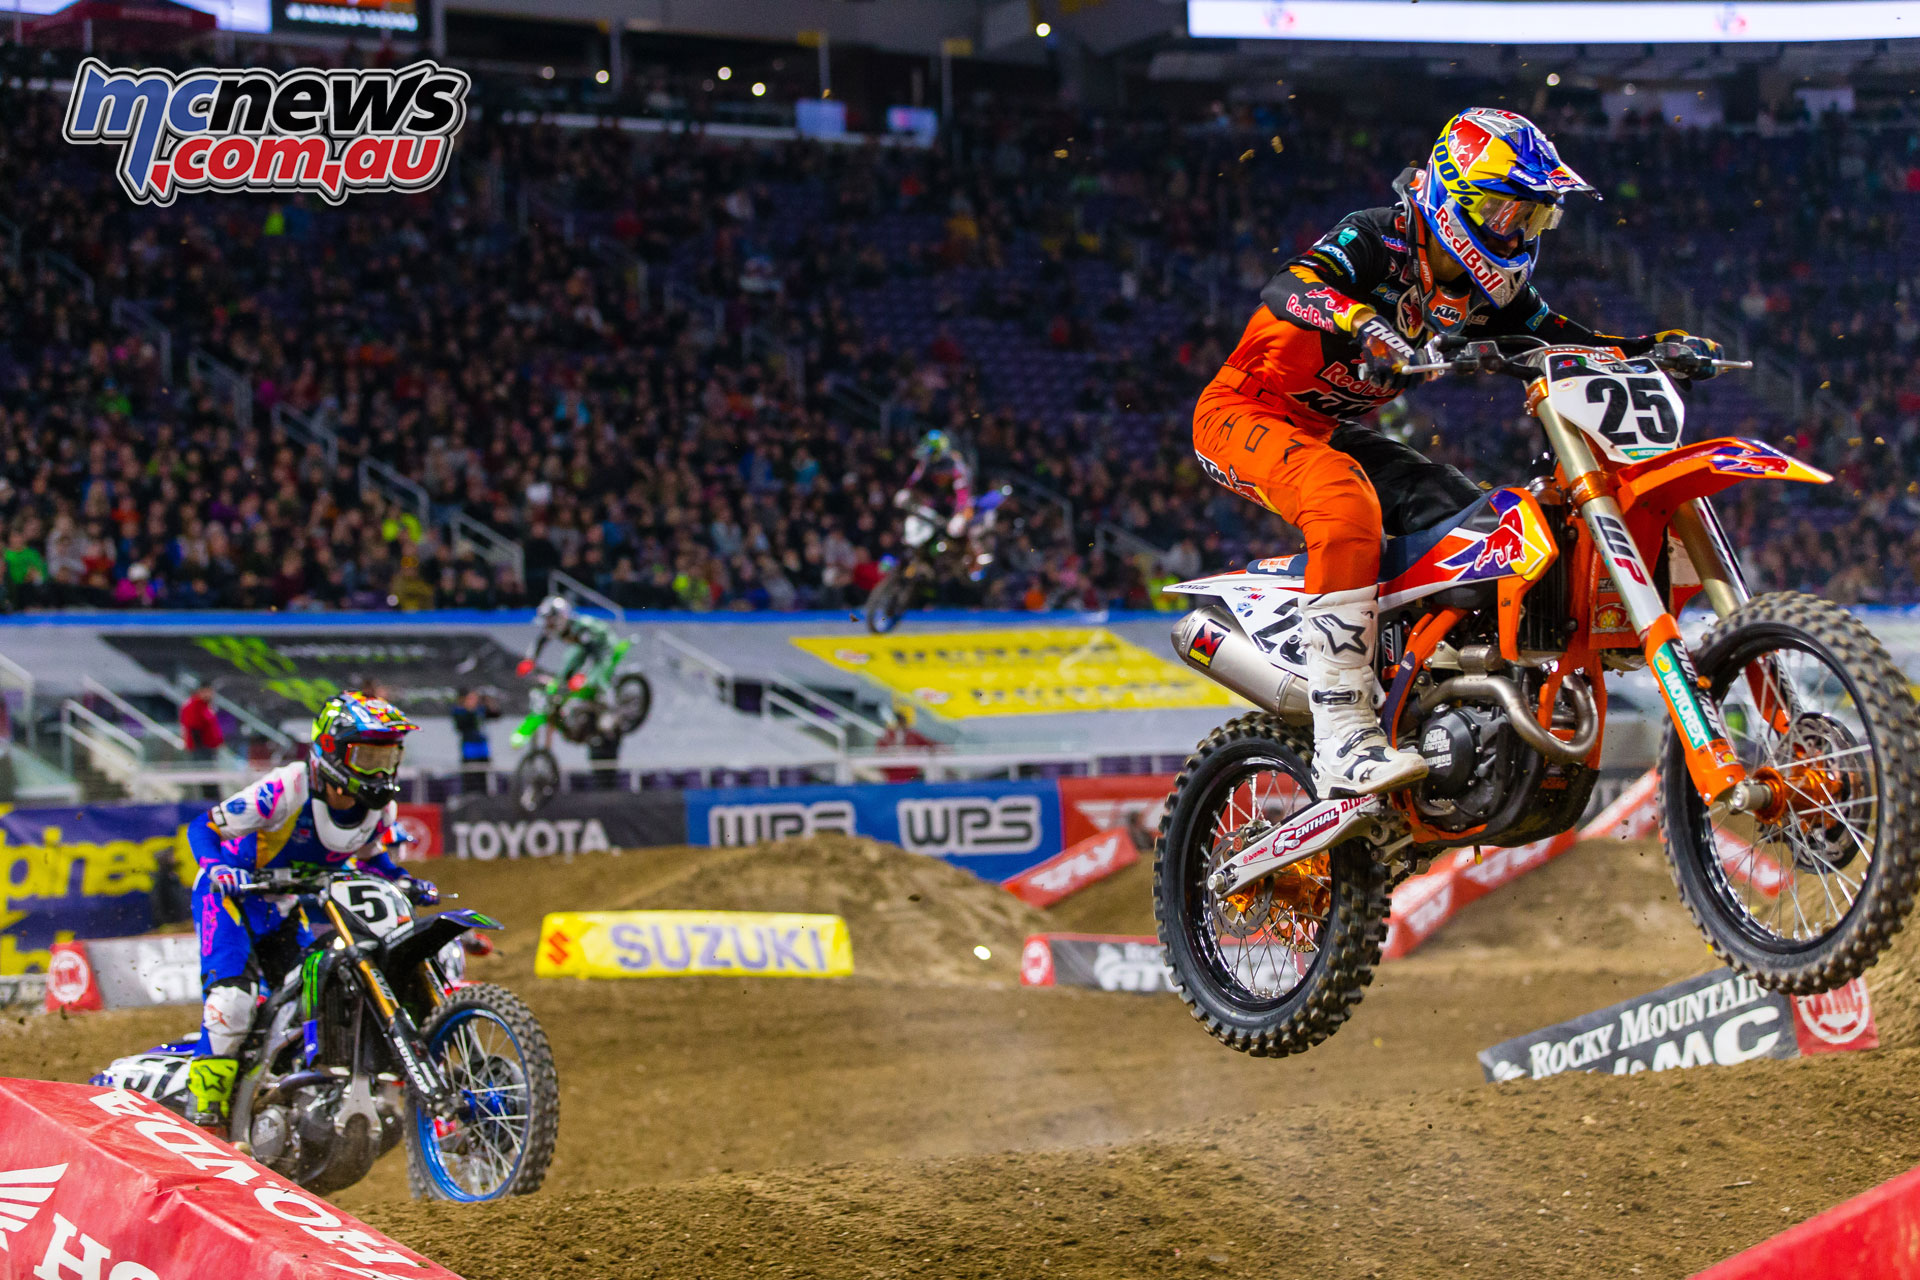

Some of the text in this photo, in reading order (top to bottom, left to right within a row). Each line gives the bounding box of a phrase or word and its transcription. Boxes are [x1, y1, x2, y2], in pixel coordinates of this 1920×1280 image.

[1434, 134, 1484, 208] 100%
[1434, 206, 1470, 255] Red
[1461, 247, 1506, 293] Bull
[1285, 293, 1314, 322] Red
[1432, 304, 1461, 323] KTM
[1364, 320, 1415, 357] THOR
[1320, 360, 1373, 394] Red
[1585, 377, 1679, 445] 25
[1594, 515, 1649, 587] WP
[1663, 670, 1704, 747] MOTOREX
[452, 818, 610, 861] TOYOTA
[906, 804, 1034, 848] WPS
[610, 923, 826, 972] SUZUKI
[1529, 1024, 1615, 1080] ROCKY
[1616, 974, 1769, 1052] MOUNTAIN
[393, 1036, 431, 1094] DUNLOP
